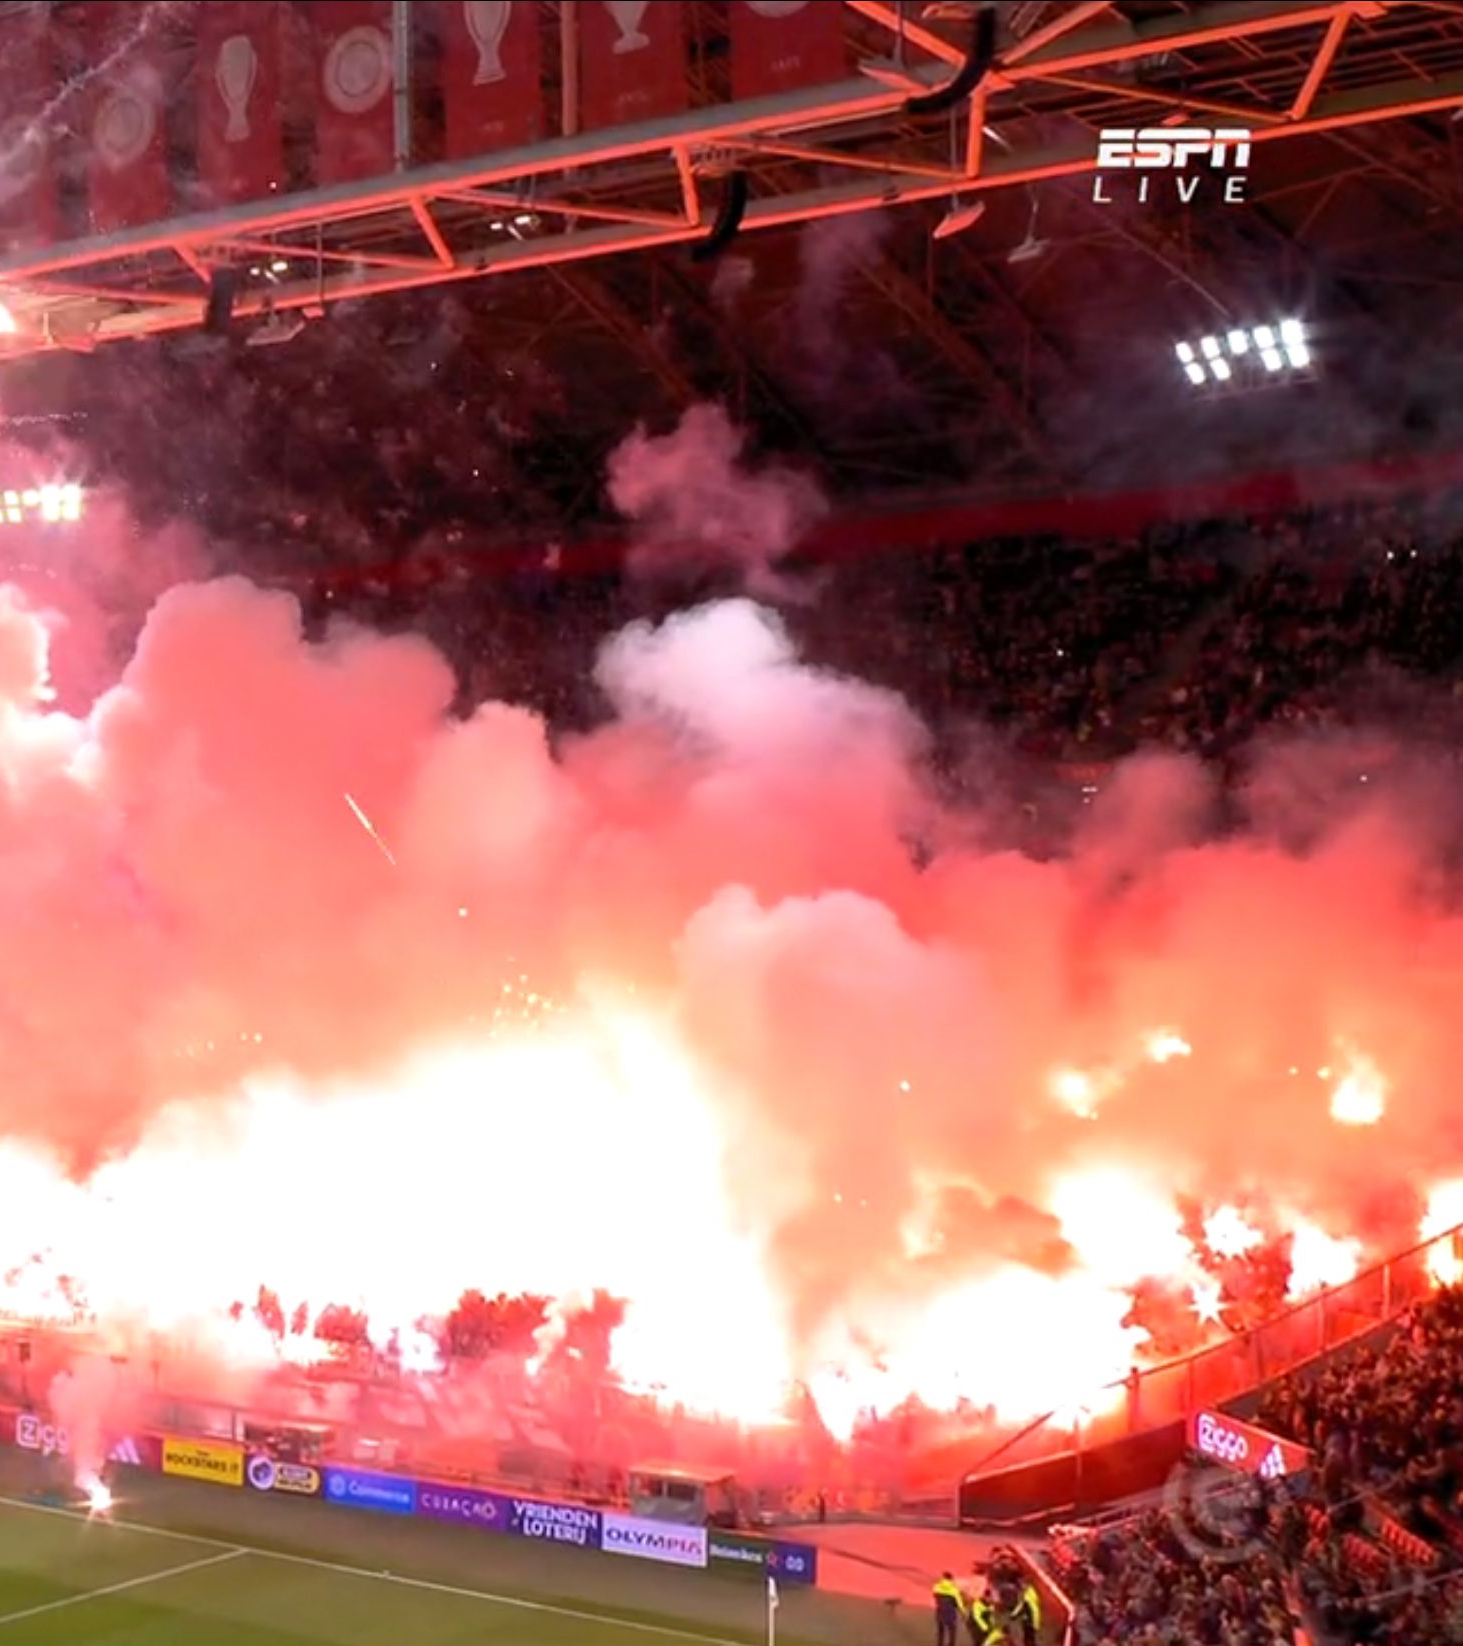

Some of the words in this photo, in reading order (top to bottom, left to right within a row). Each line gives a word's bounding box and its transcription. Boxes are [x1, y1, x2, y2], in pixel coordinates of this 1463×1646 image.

[17, 1414, 70, 1456] Zigg
[166, 1452, 227, 1472] ROCKSTARS
[513, 1500, 597, 1528] VRIENDEN
[523, 1517, 587, 1545] LOTERIJ
[606, 1527, 702, 1555] OLYMPIA
